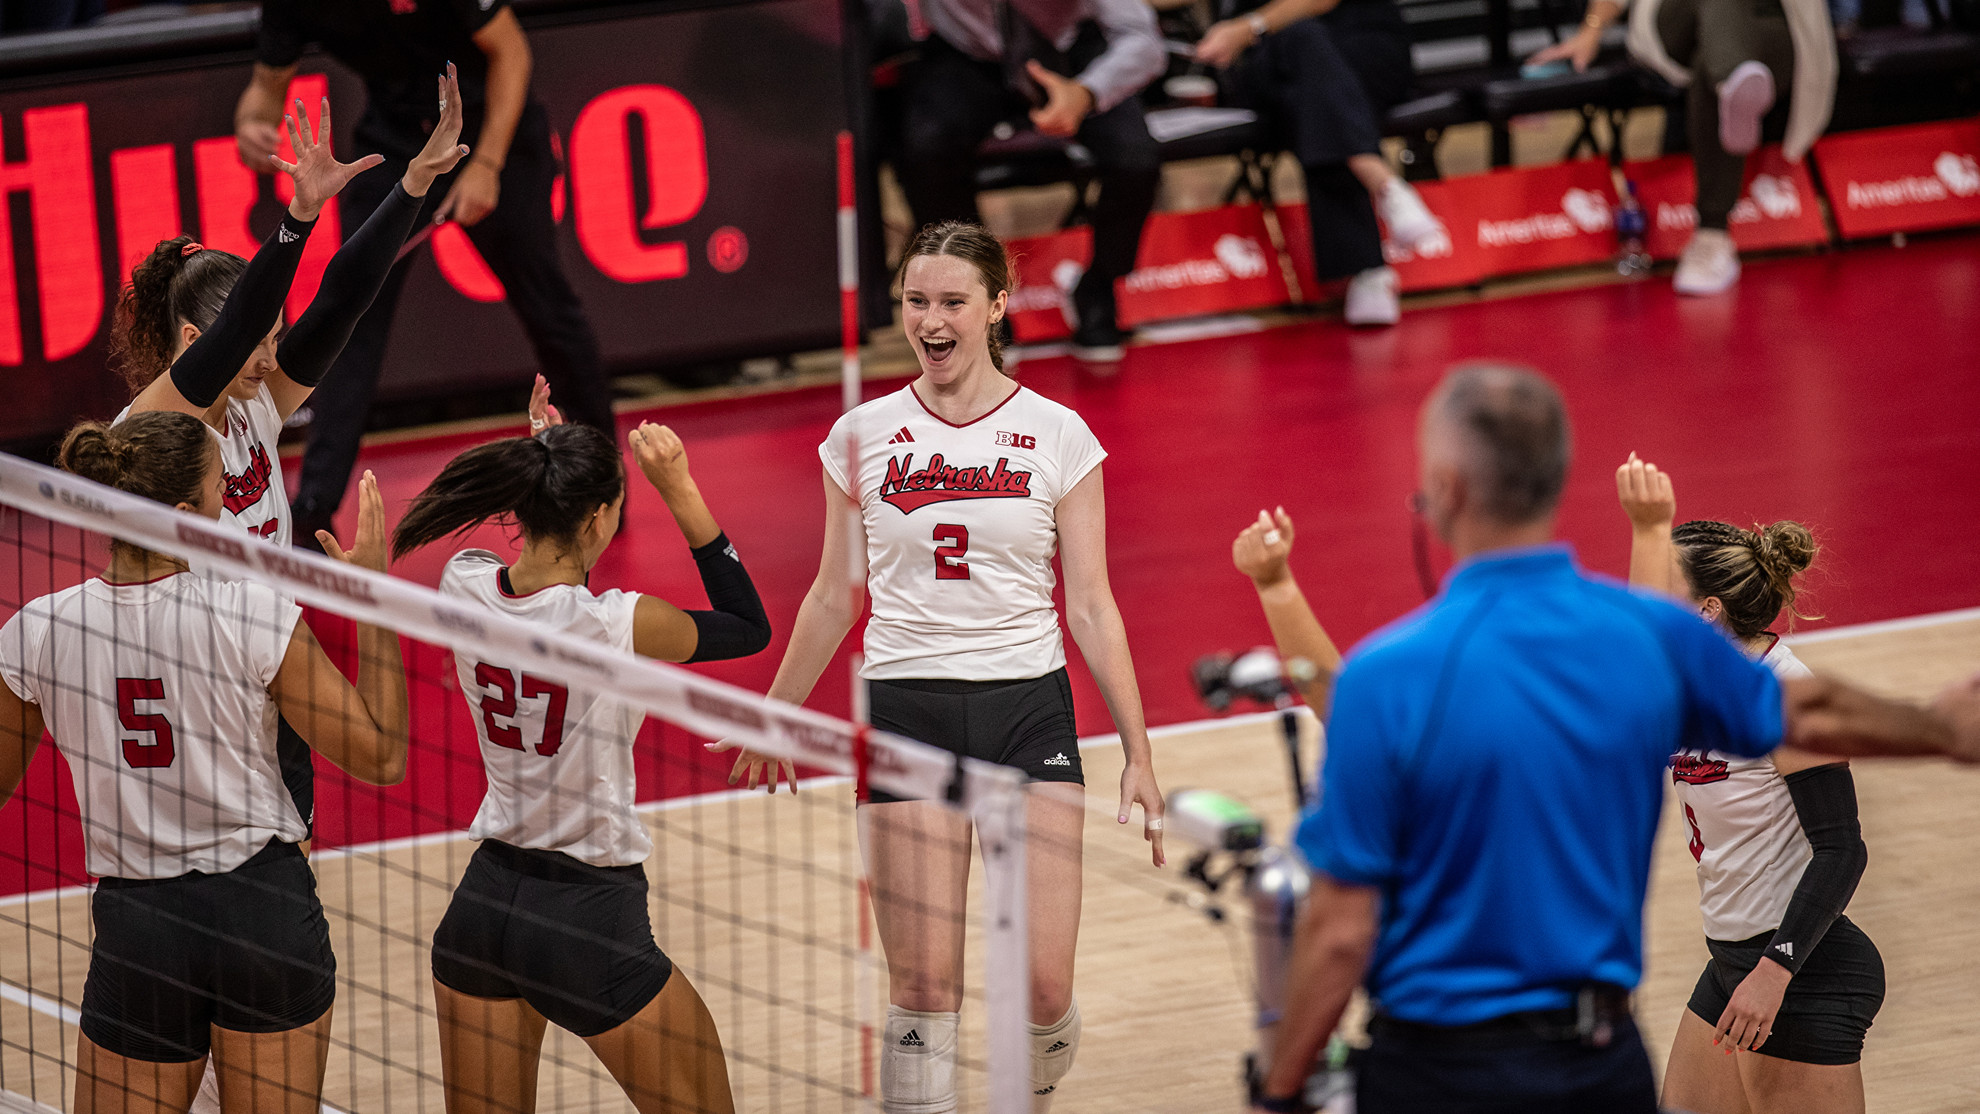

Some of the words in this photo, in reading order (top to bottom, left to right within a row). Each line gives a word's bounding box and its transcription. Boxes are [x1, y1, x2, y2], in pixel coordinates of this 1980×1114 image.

[880, 453, 1032, 498] Nebraska
[932, 523, 970, 580] 2
[116, 677, 175, 768] 5
[474, 661, 569, 758] 27
[1043, 757, 1070, 766] adidas
[900, 1039, 924, 1047] adidas
